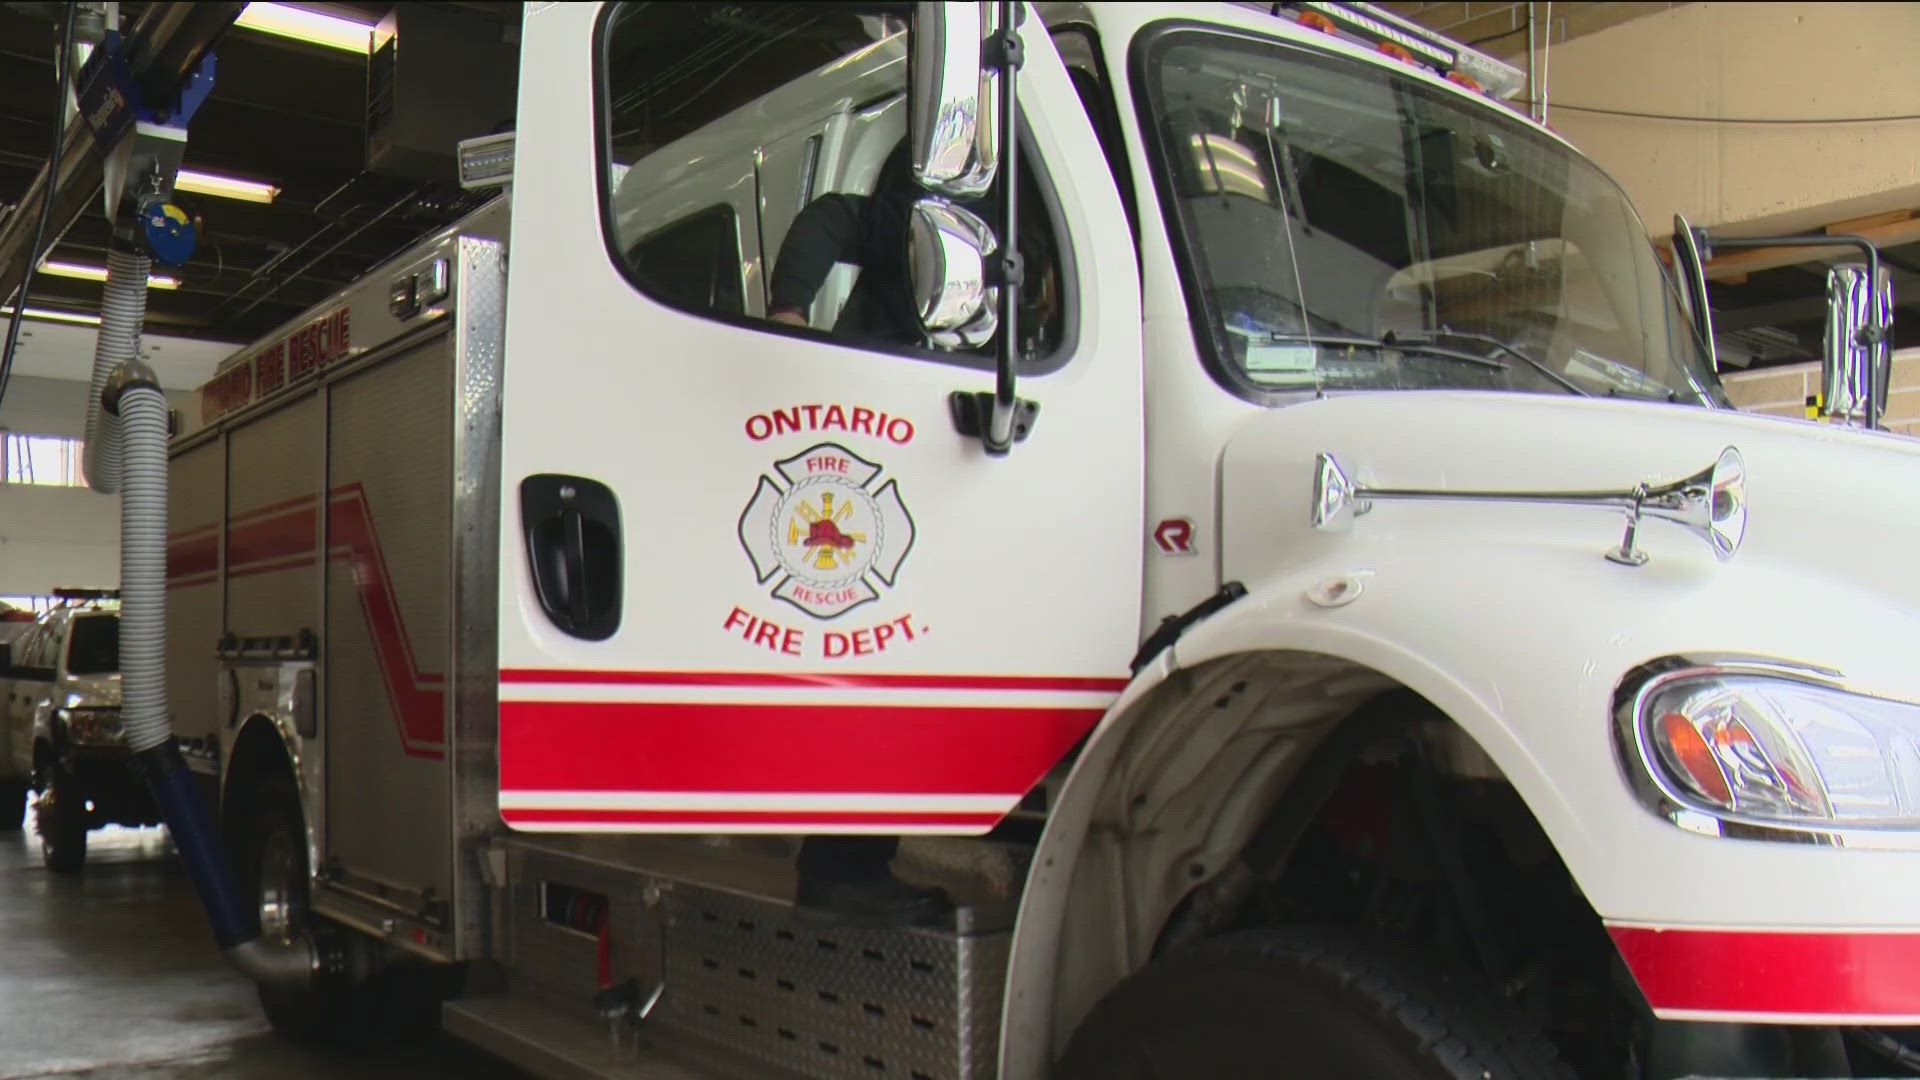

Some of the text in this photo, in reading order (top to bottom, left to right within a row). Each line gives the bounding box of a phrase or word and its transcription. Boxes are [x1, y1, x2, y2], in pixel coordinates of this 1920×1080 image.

[288, 305, 350, 382] RESCUE
[745, 404, 915, 444] ONTARIO
[806, 456, 850, 474] FIRE
[793, 586, 857, 605] RESCUE
[723, 606, 929, 659] FIRE DEPT.
